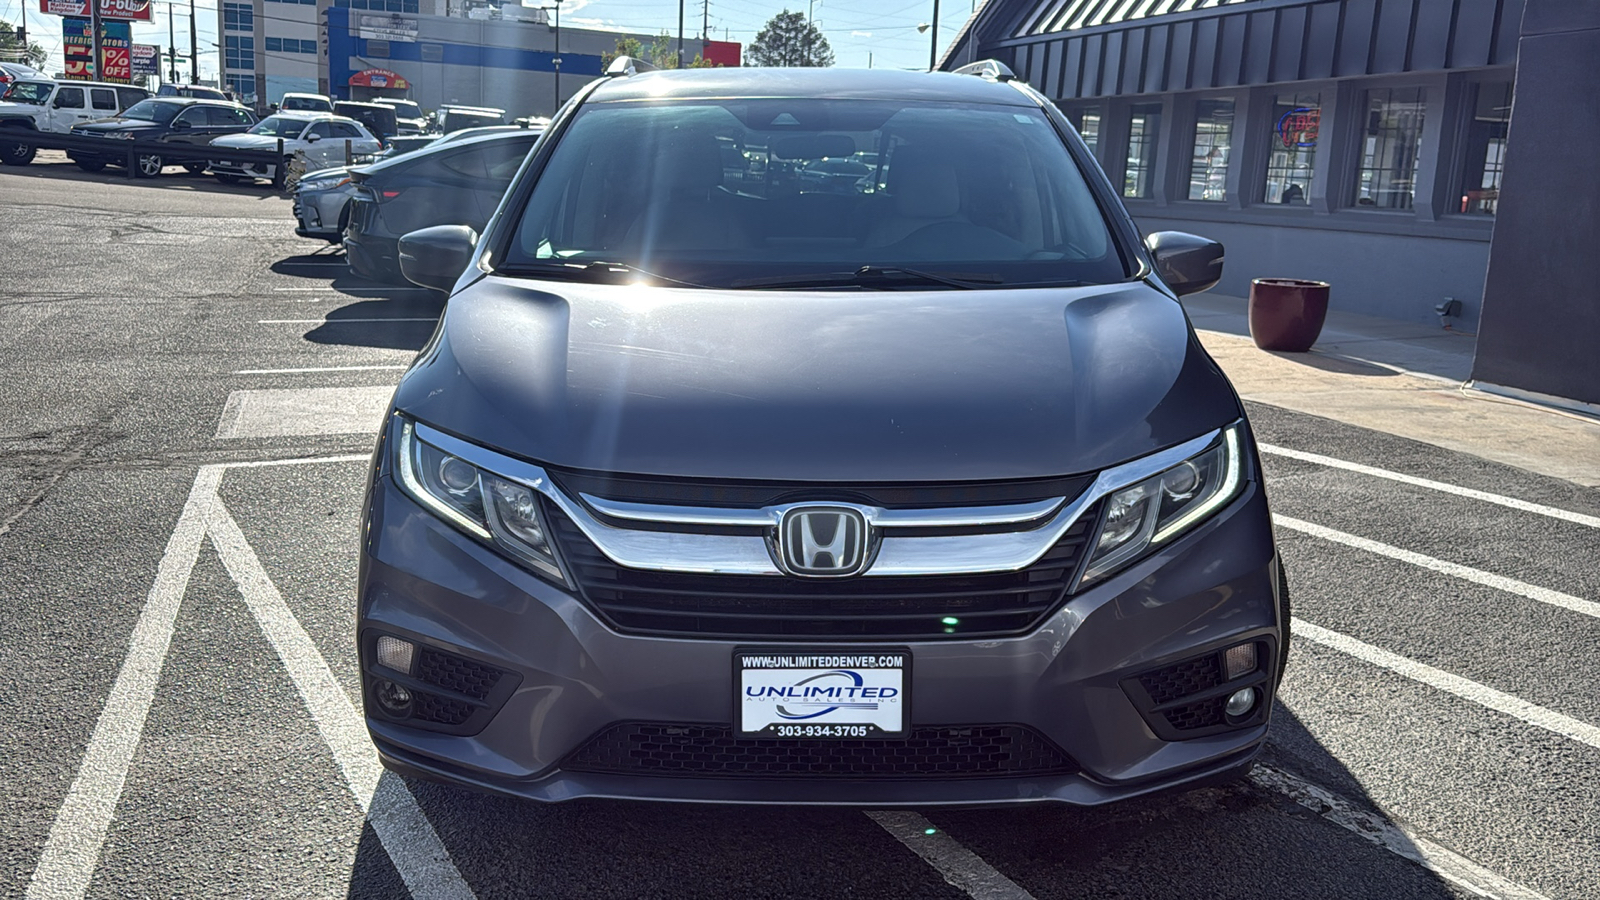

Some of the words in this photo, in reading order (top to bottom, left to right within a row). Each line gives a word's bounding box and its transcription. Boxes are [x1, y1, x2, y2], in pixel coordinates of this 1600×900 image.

[105, 66, 130, 76] OFF
[363, 69, 395, 78] ENTRANCE
[741, 656, 903, 668] WWW.UNLIMITEDDENVER.COM
[746, 686, 899, 698] UNLIMITED
[777, 725, 867, 737] 303-934-3705
